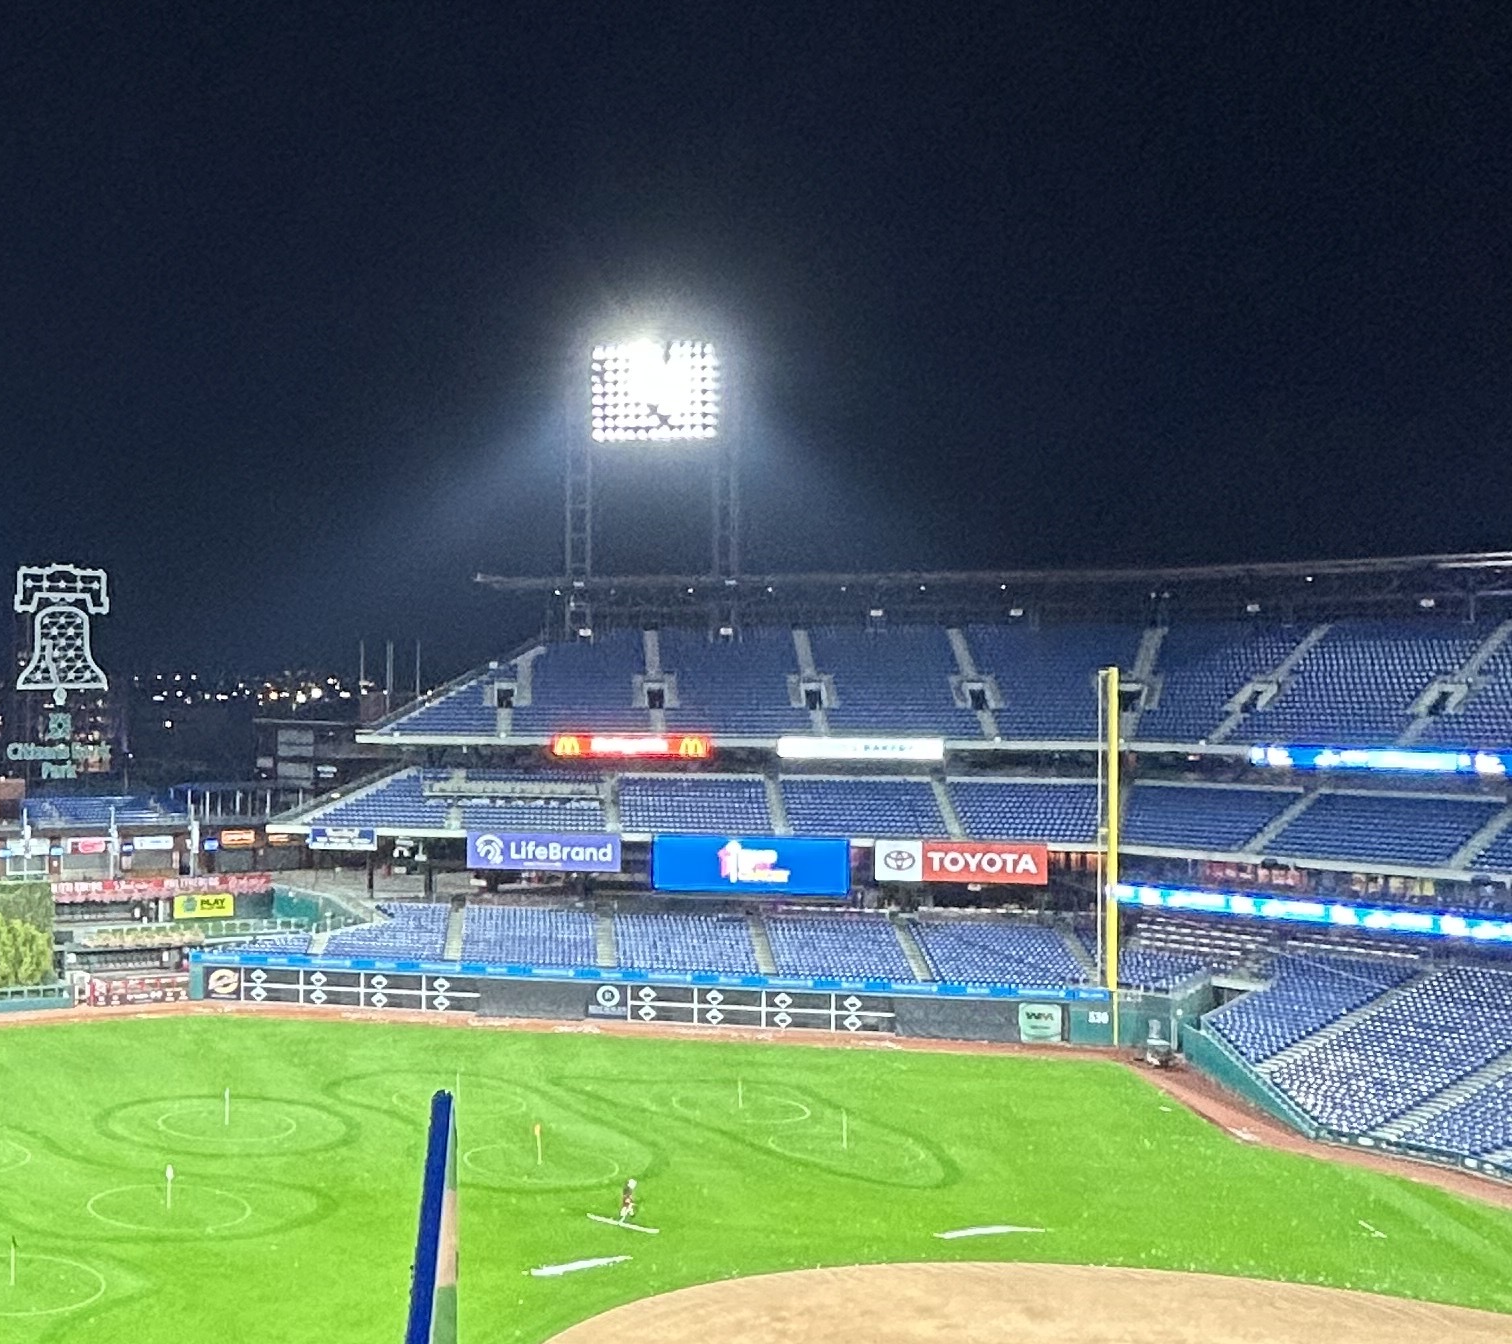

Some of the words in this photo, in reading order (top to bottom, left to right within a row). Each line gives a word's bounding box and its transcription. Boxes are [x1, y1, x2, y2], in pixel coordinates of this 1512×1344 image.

[510, 840, 613, 862] LifeBrand
[927, 851, 1038, 875] TOYOTA
[200, 898, 225, 906] PLAY
